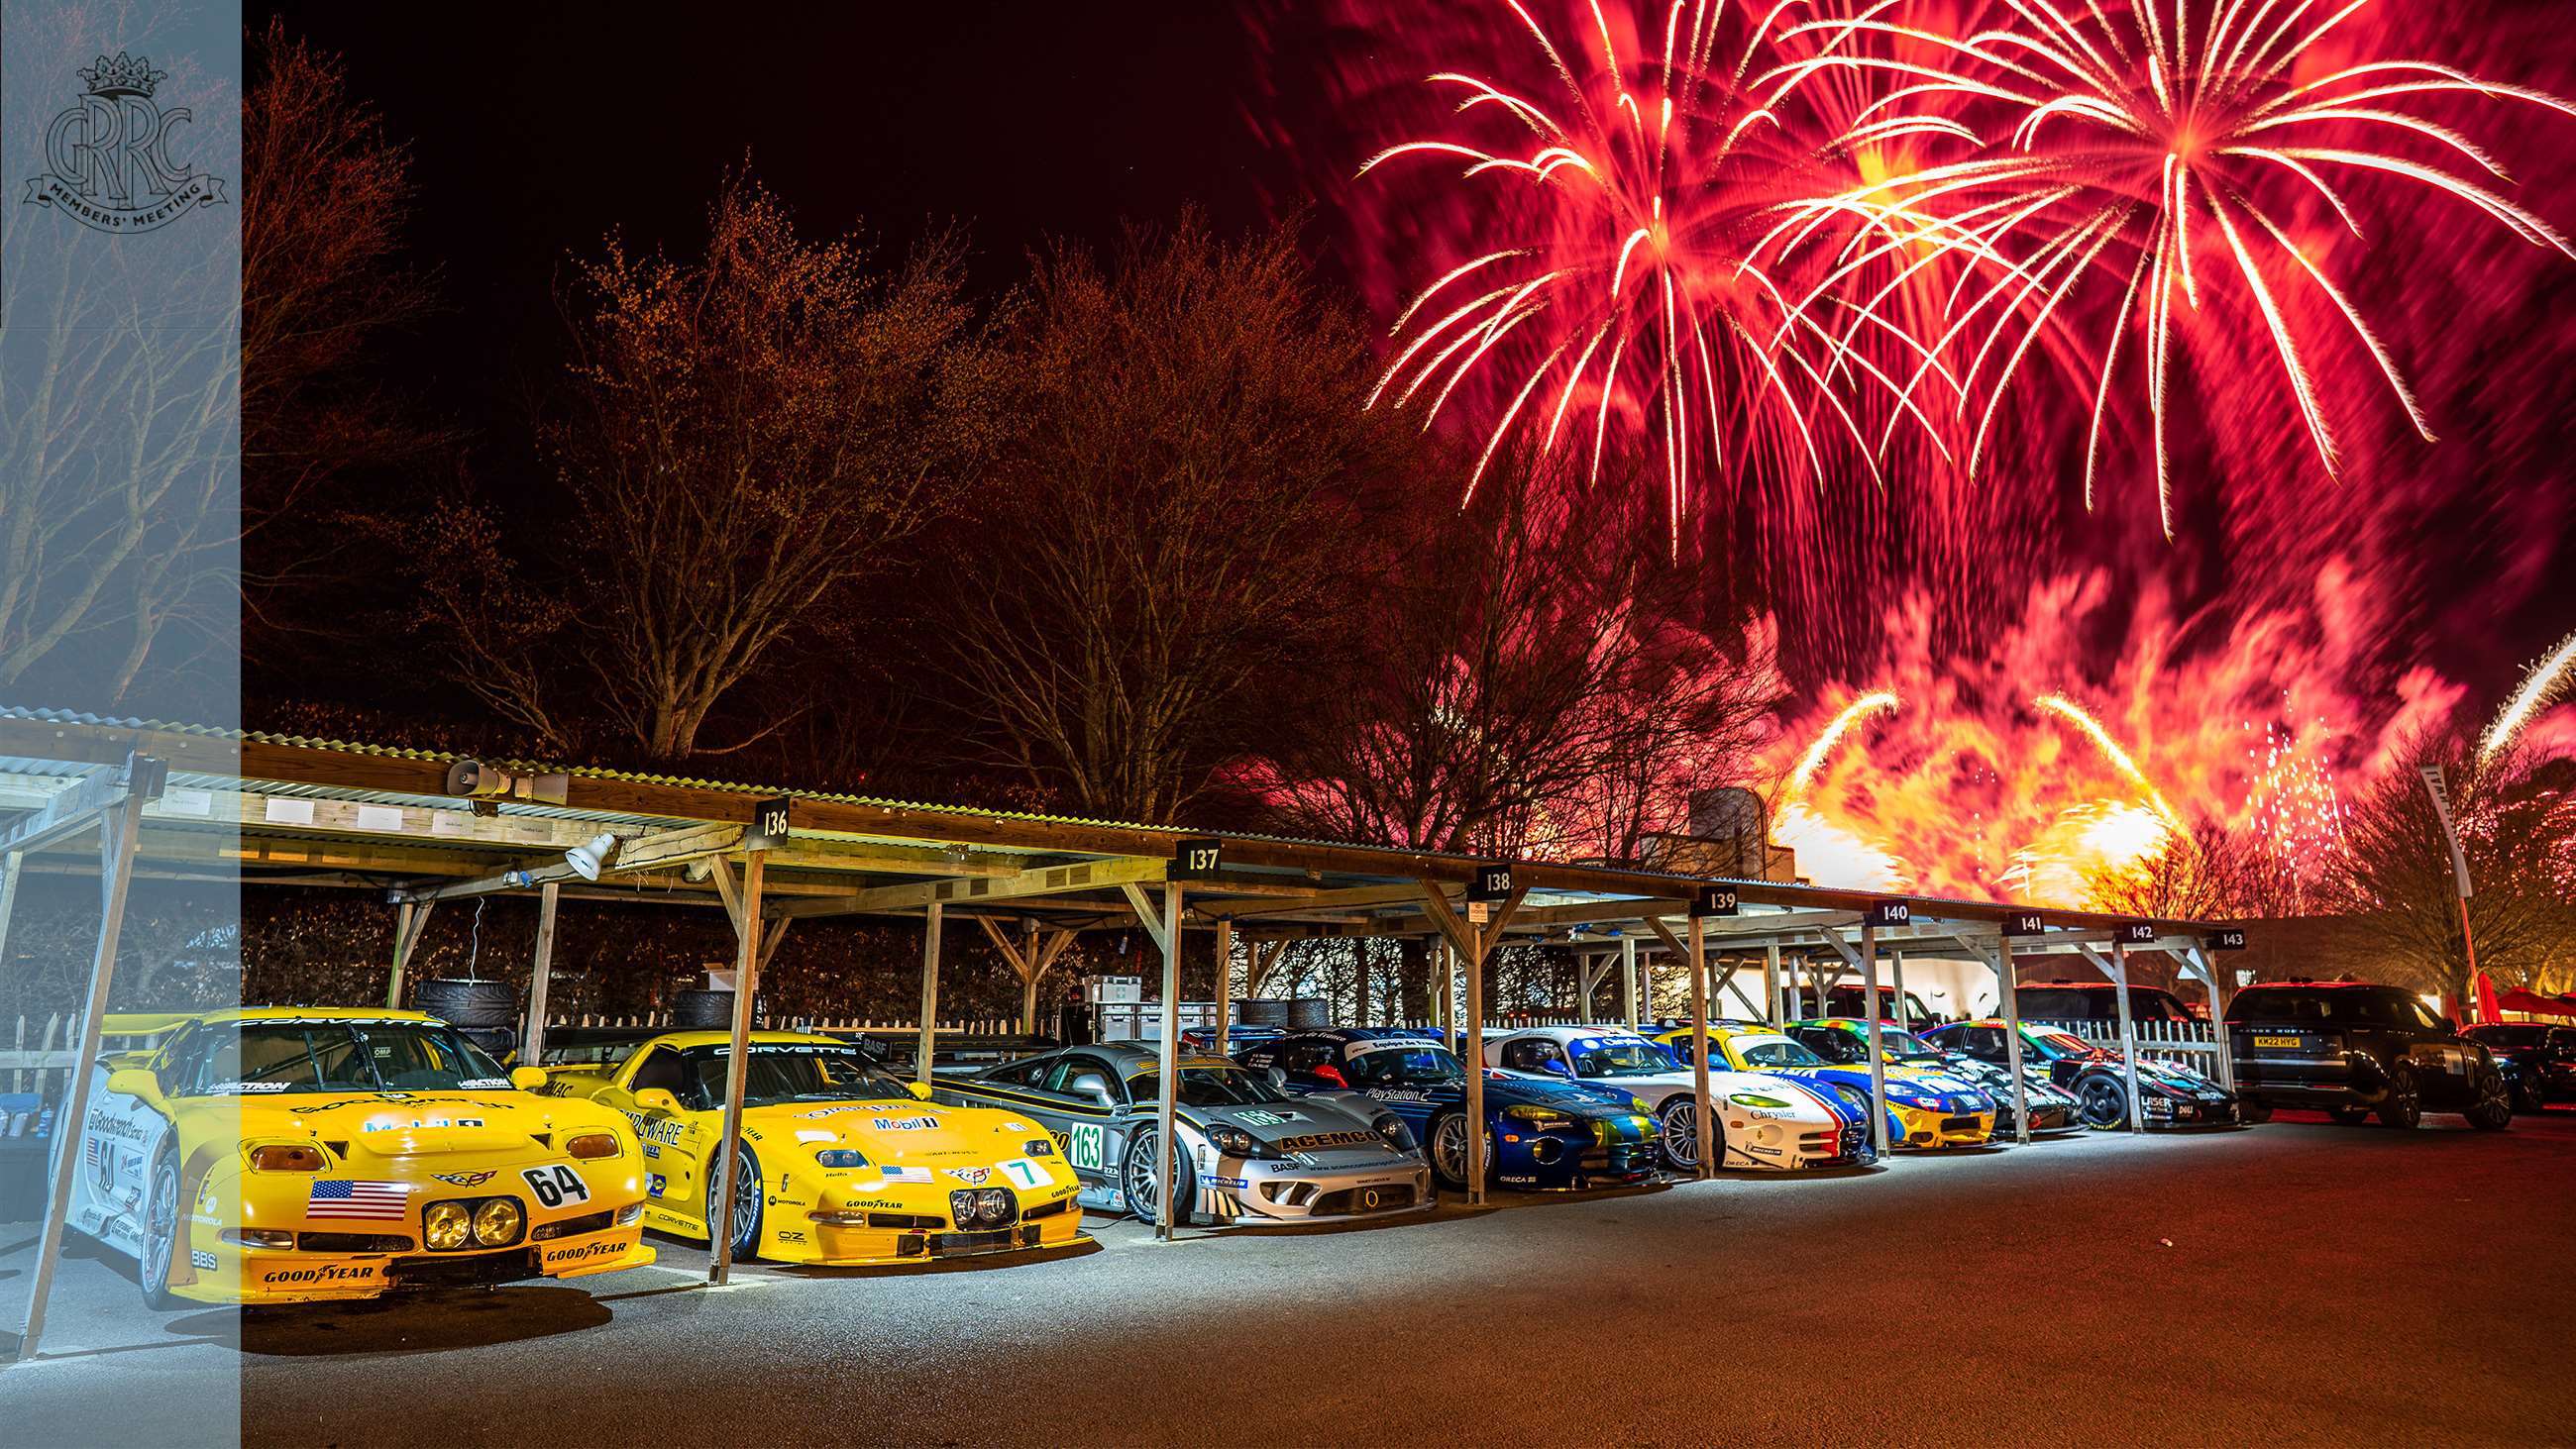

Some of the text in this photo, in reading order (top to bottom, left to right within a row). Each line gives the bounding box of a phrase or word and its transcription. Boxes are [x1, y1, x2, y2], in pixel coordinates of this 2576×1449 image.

[764, 809, 787, 837] 136
[1189, 849, 1219, 872] 137
[1487, 873, 1511, 891] 138
[1711, 892, 1737, 910] 139
[1884, 905, 1908, 921] 140
[2021, 917, 2041, 931] 141
[2132, 925, 2153, 939] 142
[2222, 933, 2243, 946] 143
[863, 1038, 887, 1054] BASF
[542, 1081, 573, 1097] MAC
[1365, 1087, 1433, 1101] PlayStation 2
[1751, 1109, 1796, 1120] Chrysler
[874, 1118, 921, 1130] Mobil
[1073, 1125, 1101, 1168] 163
[1280, 1131, 1383, 1151] ACEMCO
[1752, 1147, 1782, 1156] MICHELIN
[1007, 1161, 1036, 1186] 7
[1271, 1163, 1302, 1173] BASF
[524, 1165, 589, 1207] 64
[1210, 1178, 1246, 1188] MICHELIN
[181, 1213, 223, 1227] MOTOROLA
[658, 1213, 700, 1231] CORVETTE
[778, 1230, 805, 1241] OZ
[191, 1249, 216, 1270] BBS
